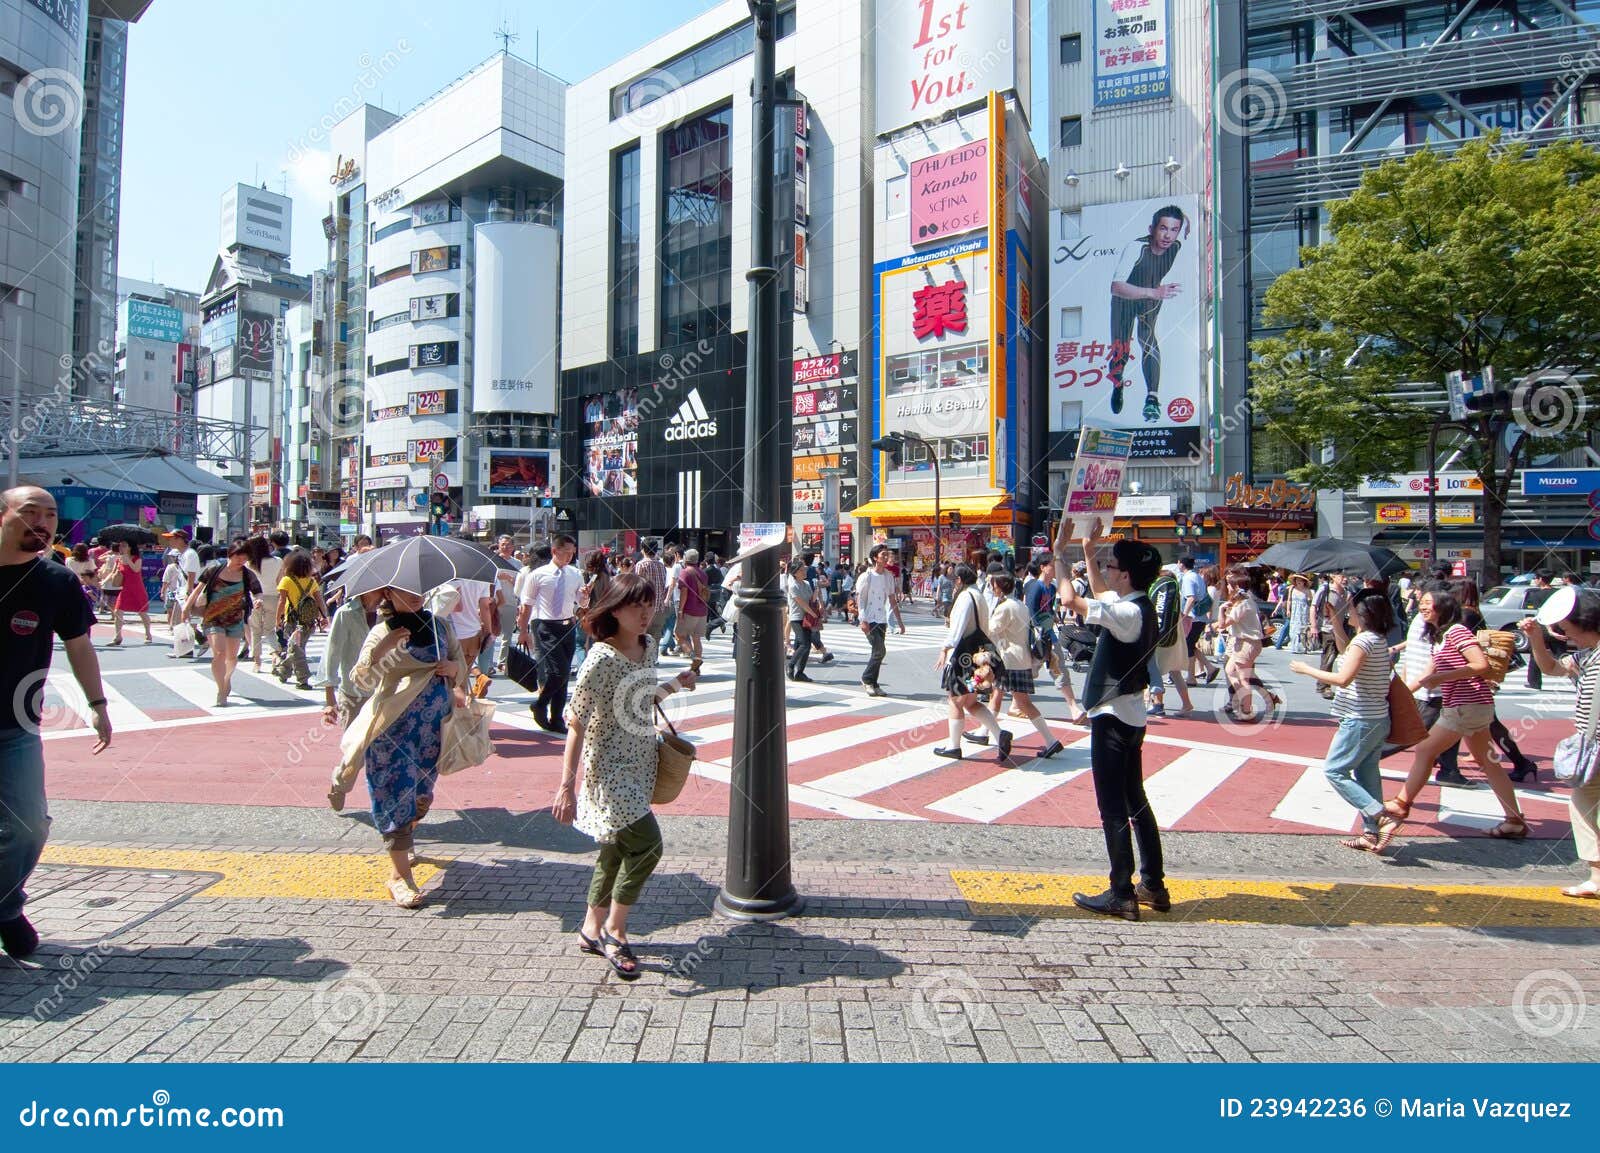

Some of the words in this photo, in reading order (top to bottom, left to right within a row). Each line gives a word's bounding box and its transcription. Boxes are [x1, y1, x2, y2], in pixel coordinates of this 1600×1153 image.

[913, 0, 968, 49] 1st
[1104, 20, 1156, 39] お茶の間
[924, 44, 958, 70] for
[911, 72, 975, 111] You.
[912, 145, 987, 178] SHISEIDO
[921, 171, 977, 197] Kanebo
[902, 249, 949, 267] Matsumoto
[913, 280, 967, 340] 薬
[795, 370, 812, 380] BIG
[813, 365, 839, 376] ECHO
[801, 357, 832, 369] カラオケ
[420, 392, 440, 408] 270
[896, 402, 932, 417] Health
[934, 402, 943, 413] &
[945, 397, 986, 412] Beauty
[664, 420, 717, 442] adidas
[418, 440, 439, 456] 270
[1225, 472, 1315, 510] グルメタウン
[1538, 477, 1577, 486] MIZUHO
[86, 489, 145, 501] MAYBELLINE
[1155, 590, 1168, 614] YONEX
